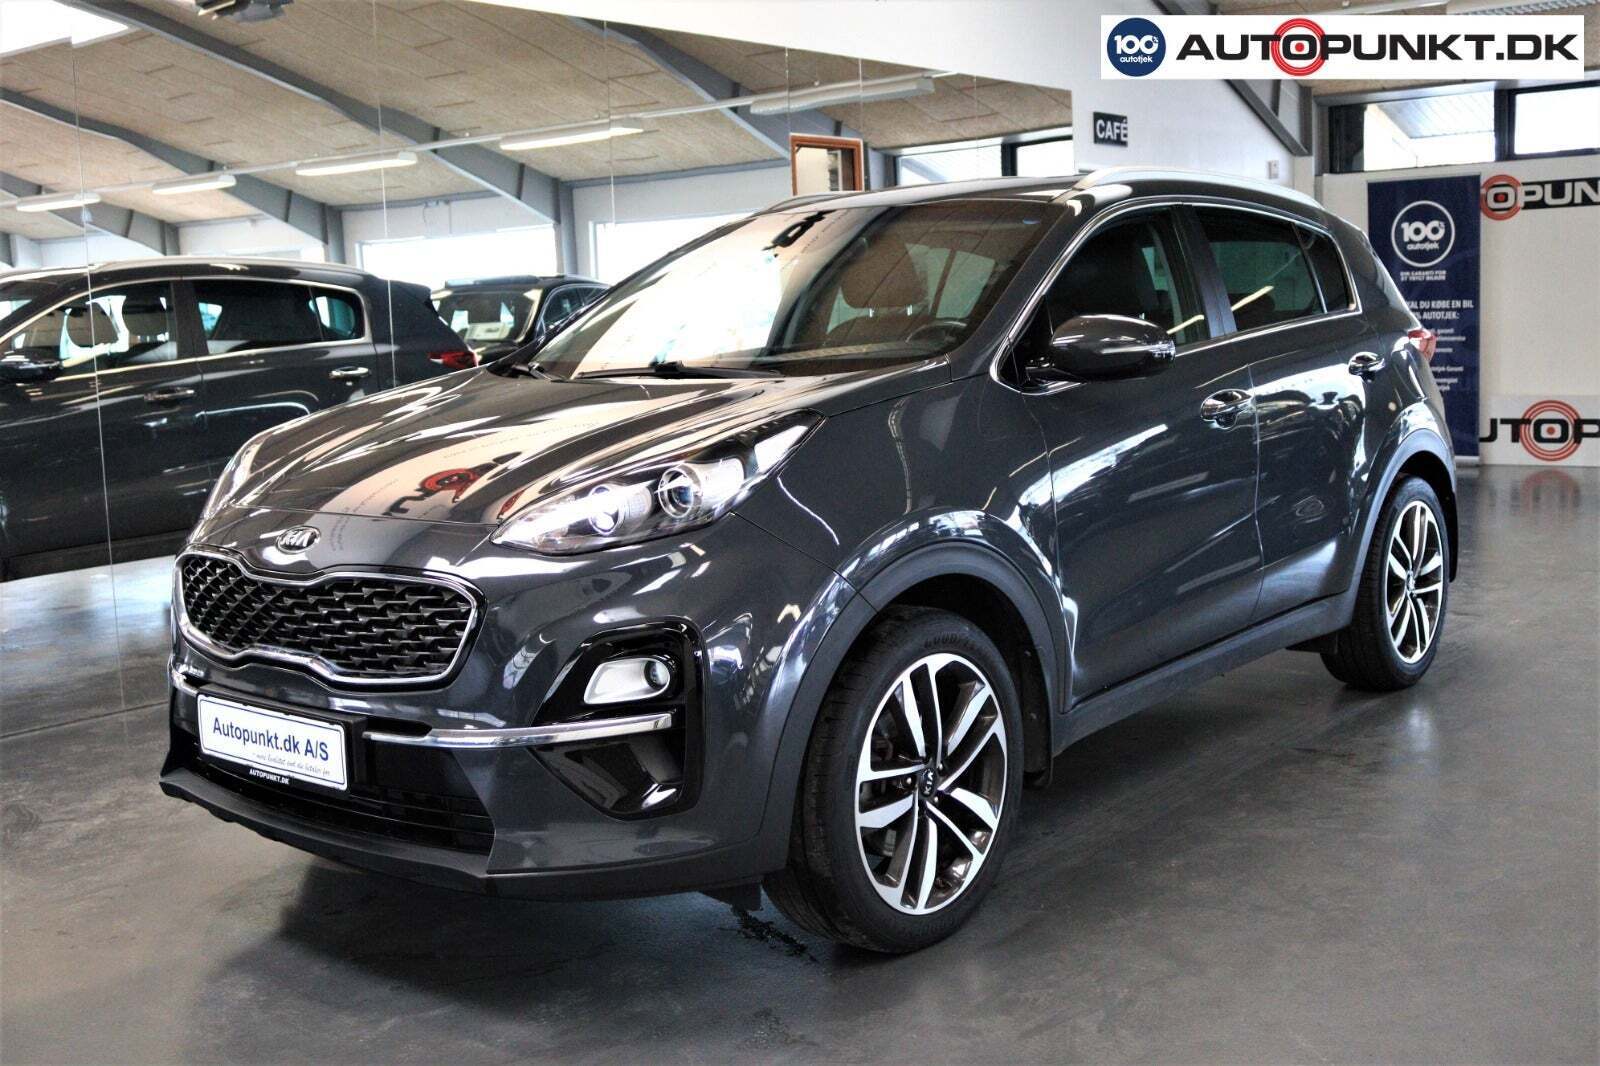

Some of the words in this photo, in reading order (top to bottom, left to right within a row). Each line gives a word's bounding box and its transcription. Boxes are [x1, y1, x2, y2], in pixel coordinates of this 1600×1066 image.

[1096, 119, 1128, 141] CAFÉ
[1480, 180, 1600, 211] OPUN
[1419, 300, 1431, 309] DU
[1452, 300, 1462, 309] EN
[1462, 299, 1474, 309] BIL
[213, 717, 301, 754] Autopunkt.dk
[304, 738, 329, 762] A/S
[249, 768, 290, 785] AUTOPUNKT.DK
